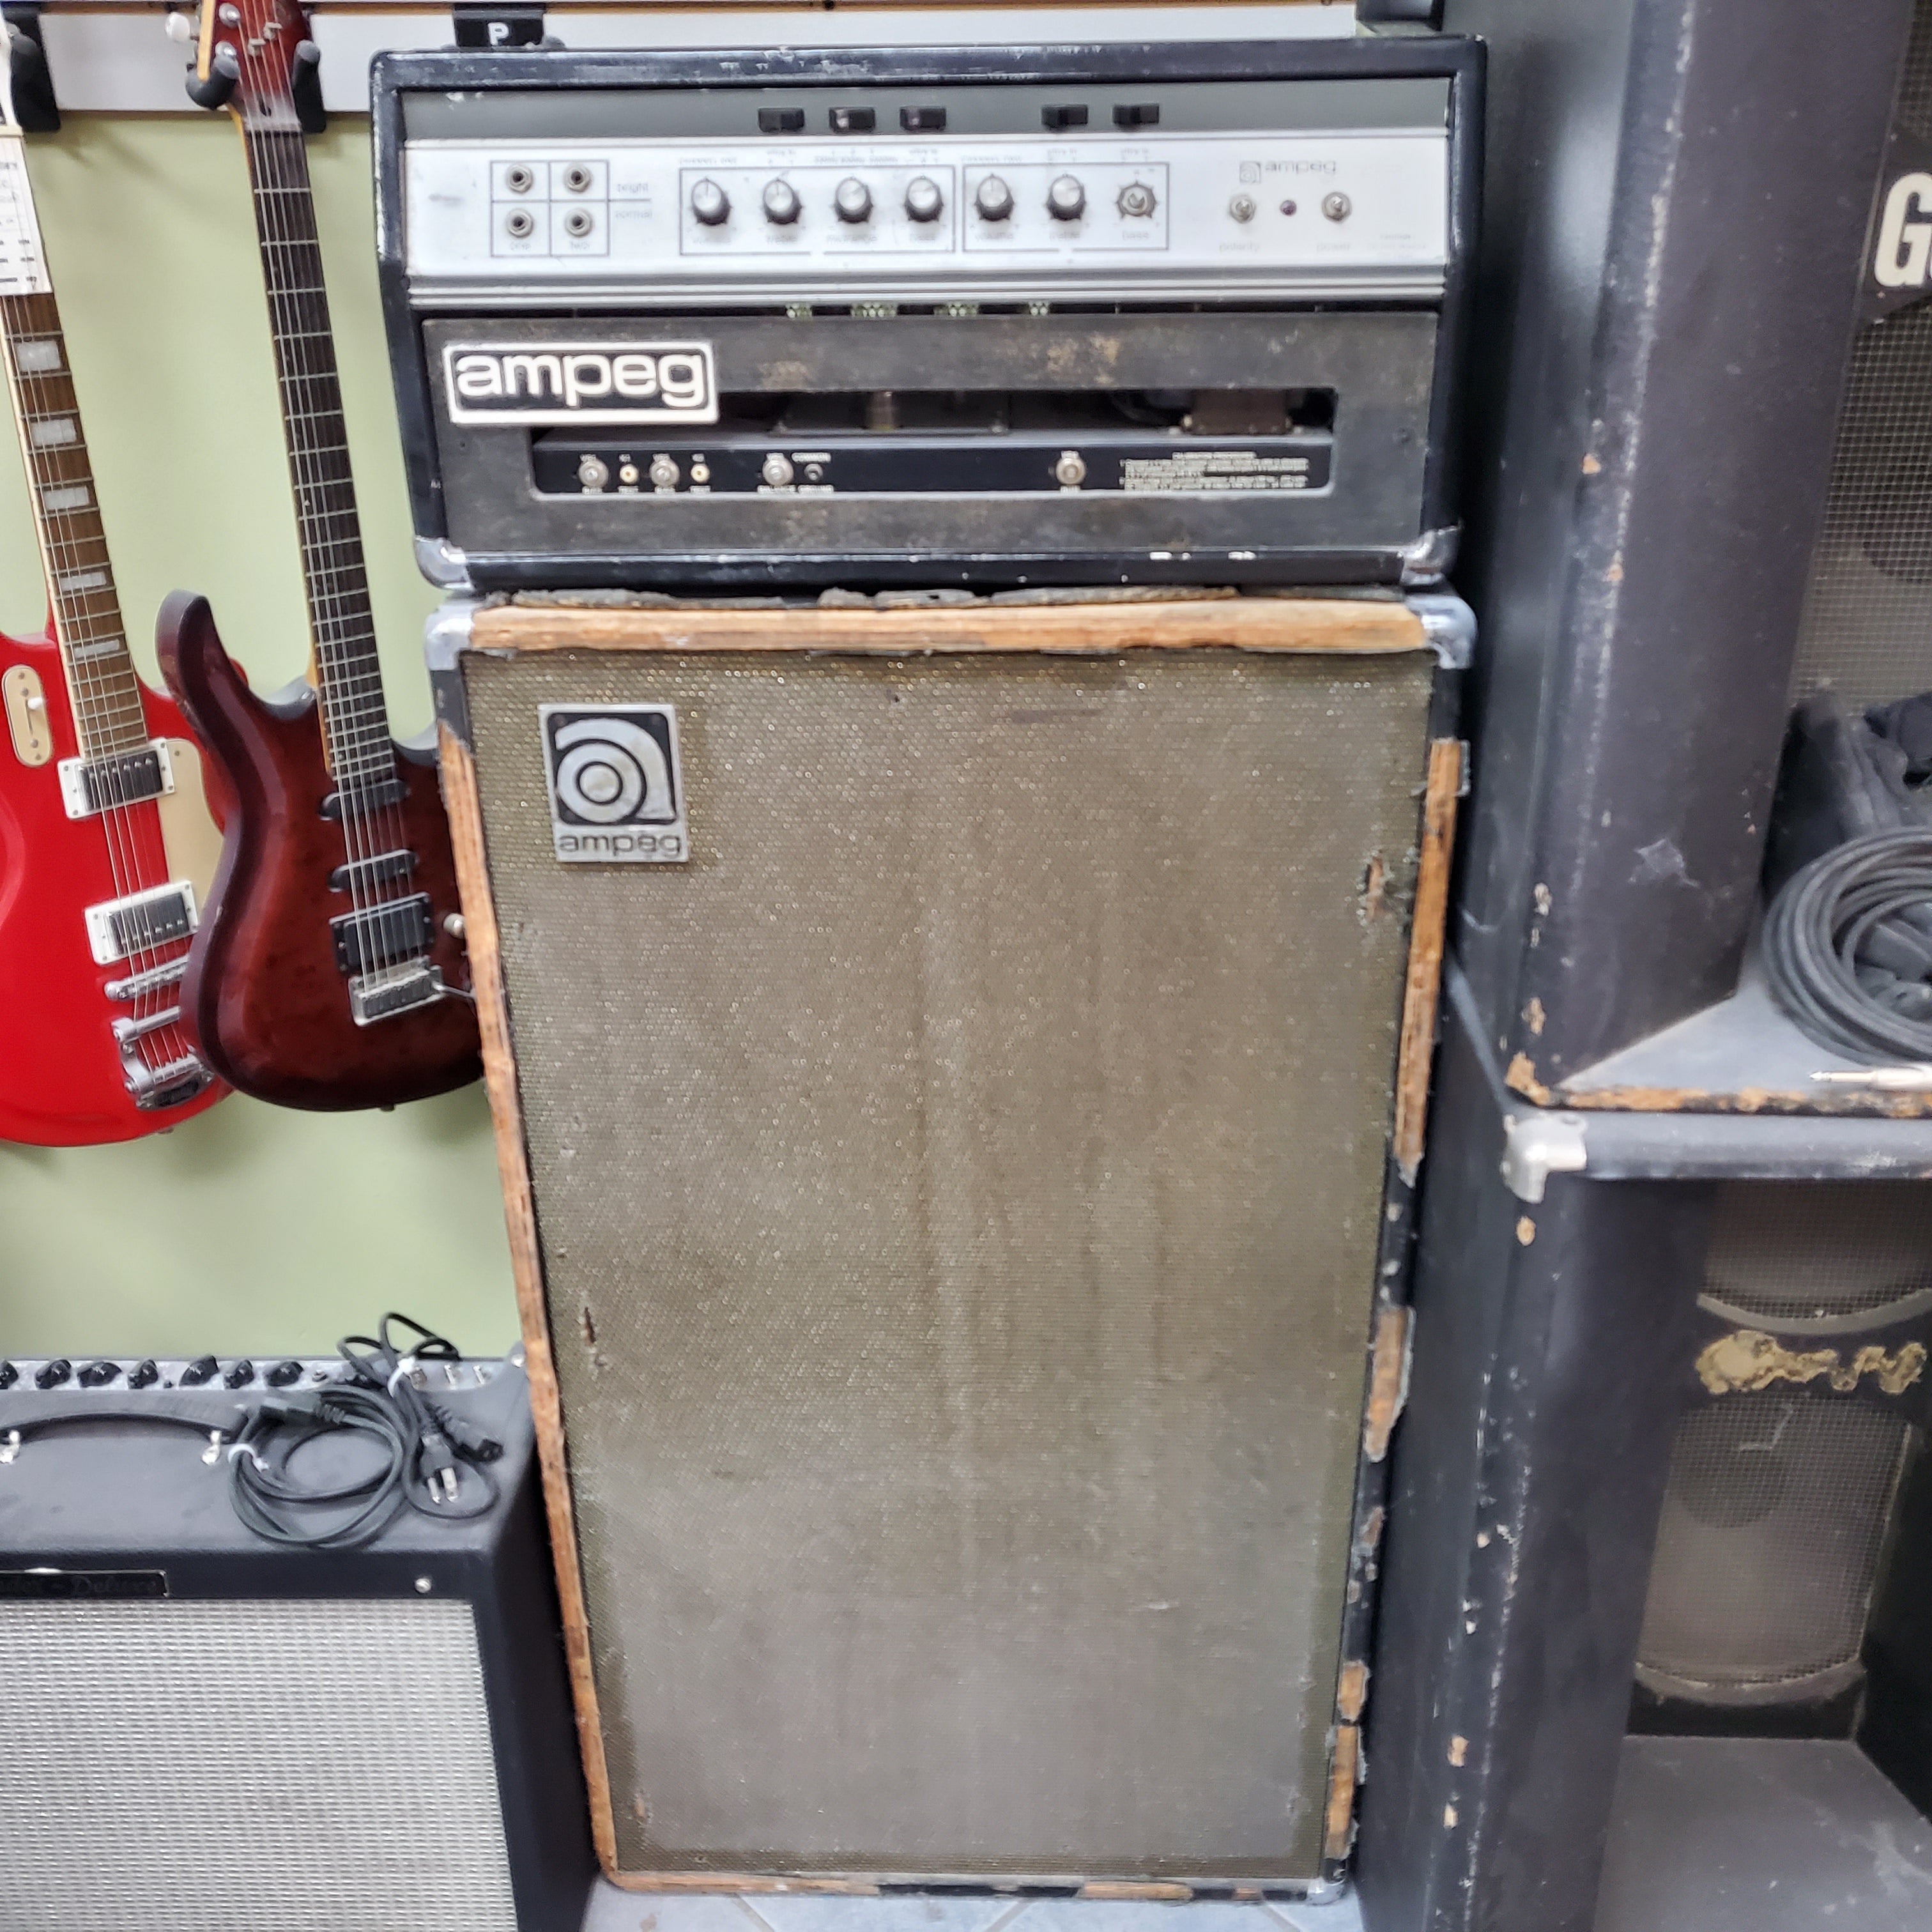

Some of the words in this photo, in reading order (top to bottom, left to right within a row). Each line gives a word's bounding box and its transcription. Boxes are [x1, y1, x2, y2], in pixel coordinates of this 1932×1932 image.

[487, 22, 509, 46] P
[1874, 172, 1932, 288] G
[456, 353, 705, 408] ampeg
[558, 834, 680, 858] ampeg
